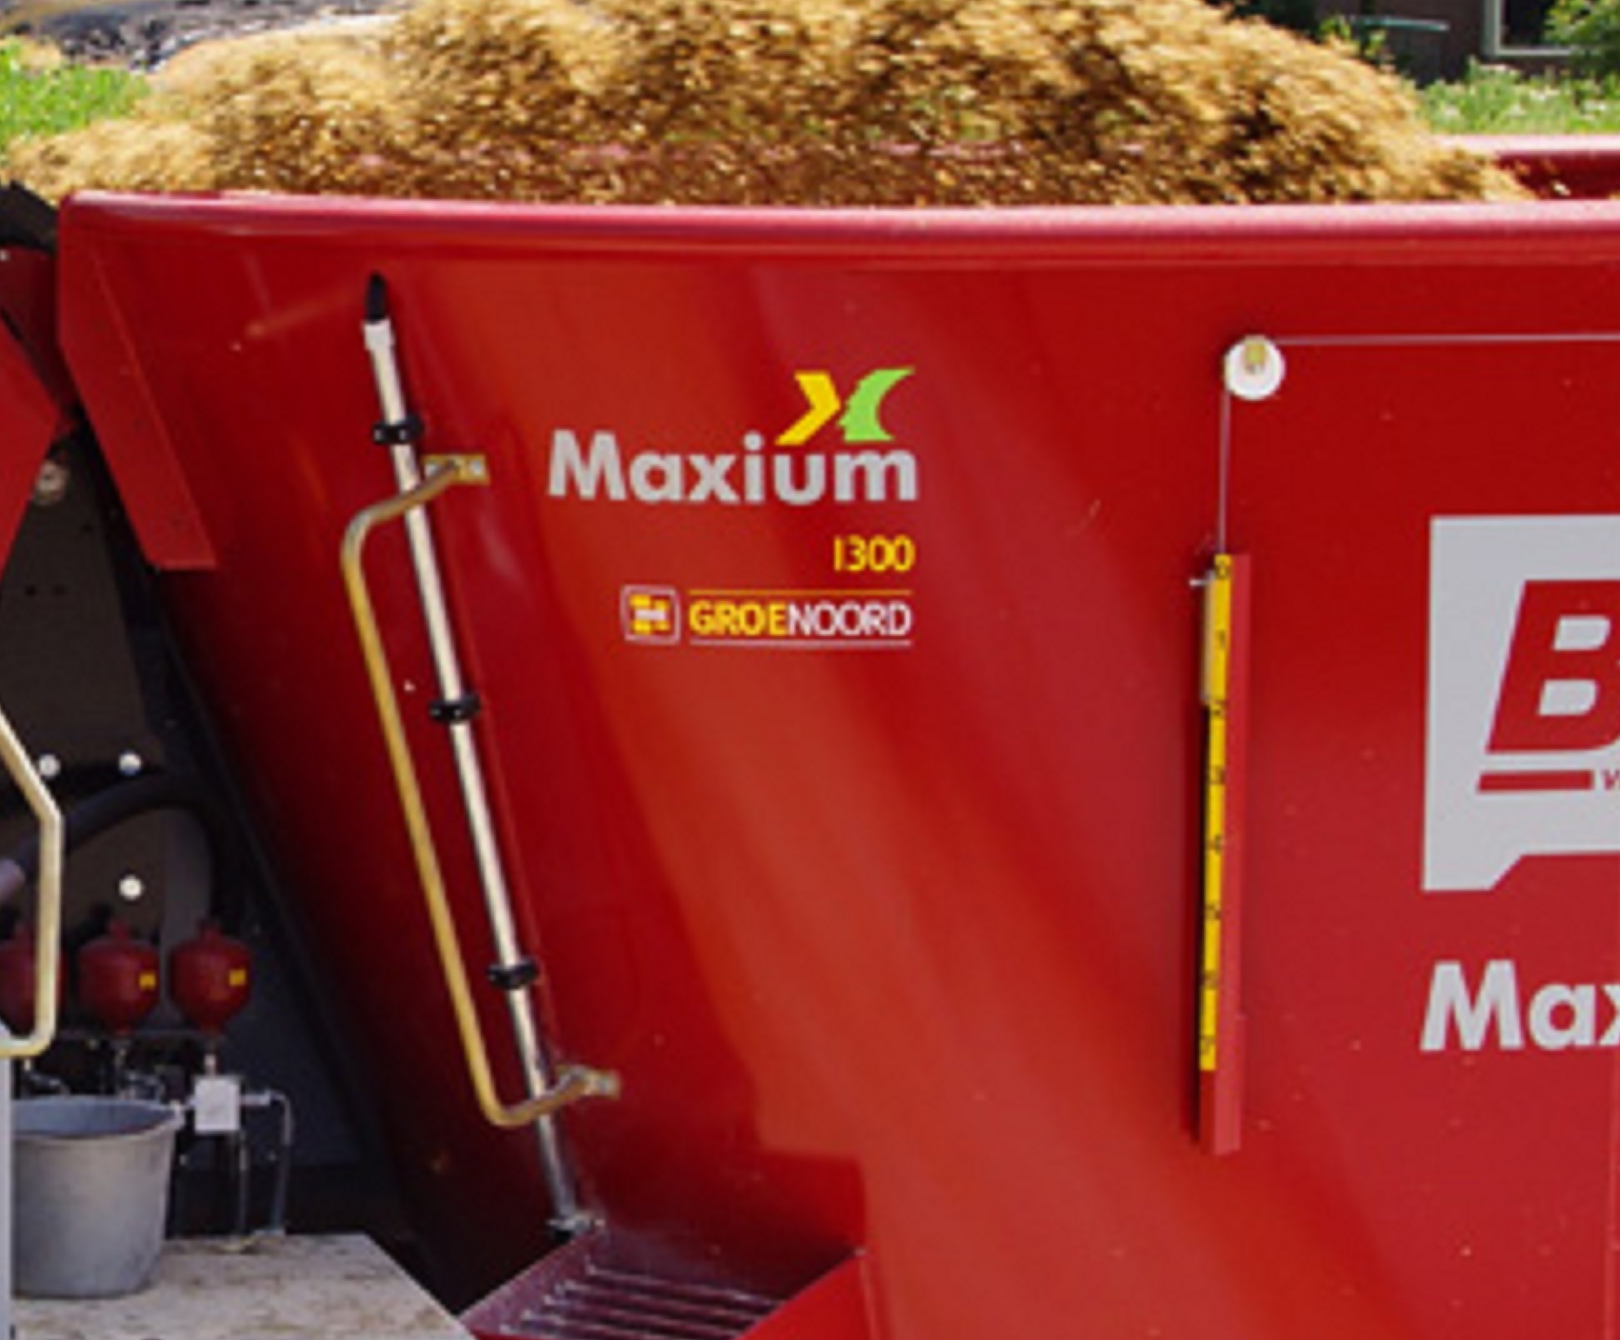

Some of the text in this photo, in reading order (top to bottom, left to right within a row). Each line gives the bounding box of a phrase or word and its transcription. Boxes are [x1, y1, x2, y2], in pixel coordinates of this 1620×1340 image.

[547, 429, 918, 505] Maxium
[833, 534, 916, 573] 1300
[688, 599, 913, 637] GROENOORD
